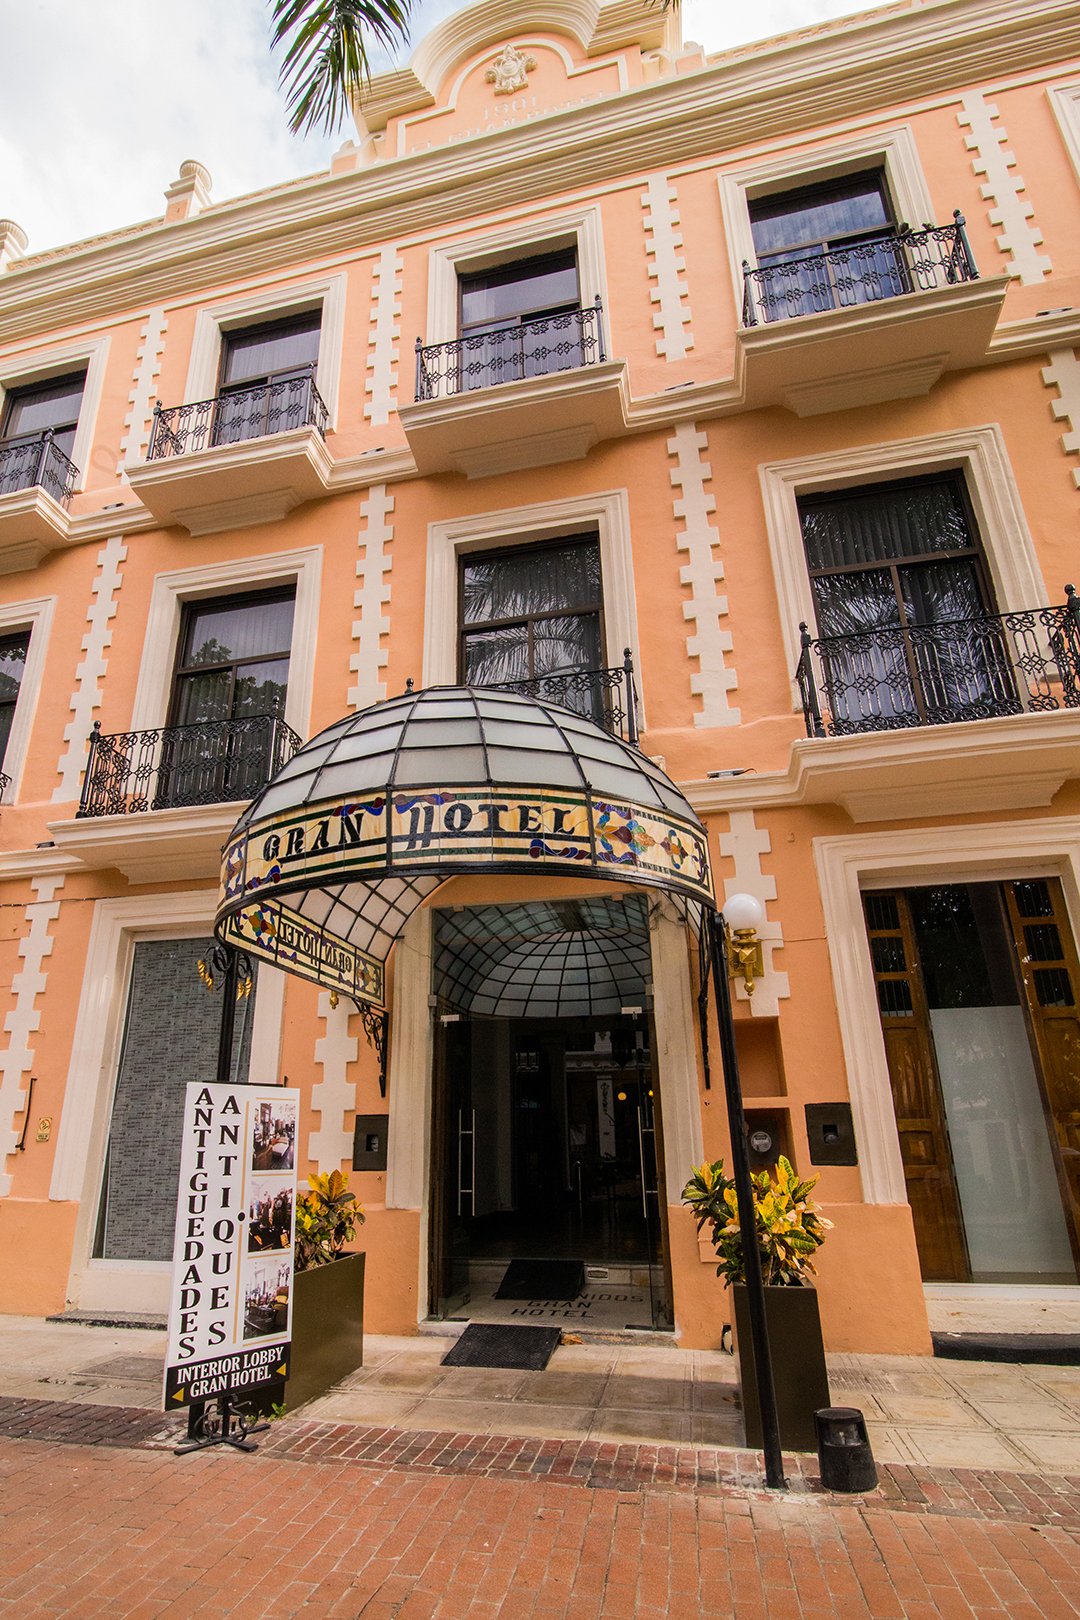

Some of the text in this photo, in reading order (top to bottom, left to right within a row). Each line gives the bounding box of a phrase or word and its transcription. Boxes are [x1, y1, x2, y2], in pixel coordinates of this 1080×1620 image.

[263, 803, 577, 862] GRAN HOTEL
[177, 1087, 215, 1360] ANTIGUEDADES
[207, 1095, 242, 1347] ANTIQUES
[511, 1308, 595, 1318] HOTEL
[176, 1346, 284, 1384] INTERIOR LOBBY
[190, 1365, 271, 1398] GRAN HOTEL
